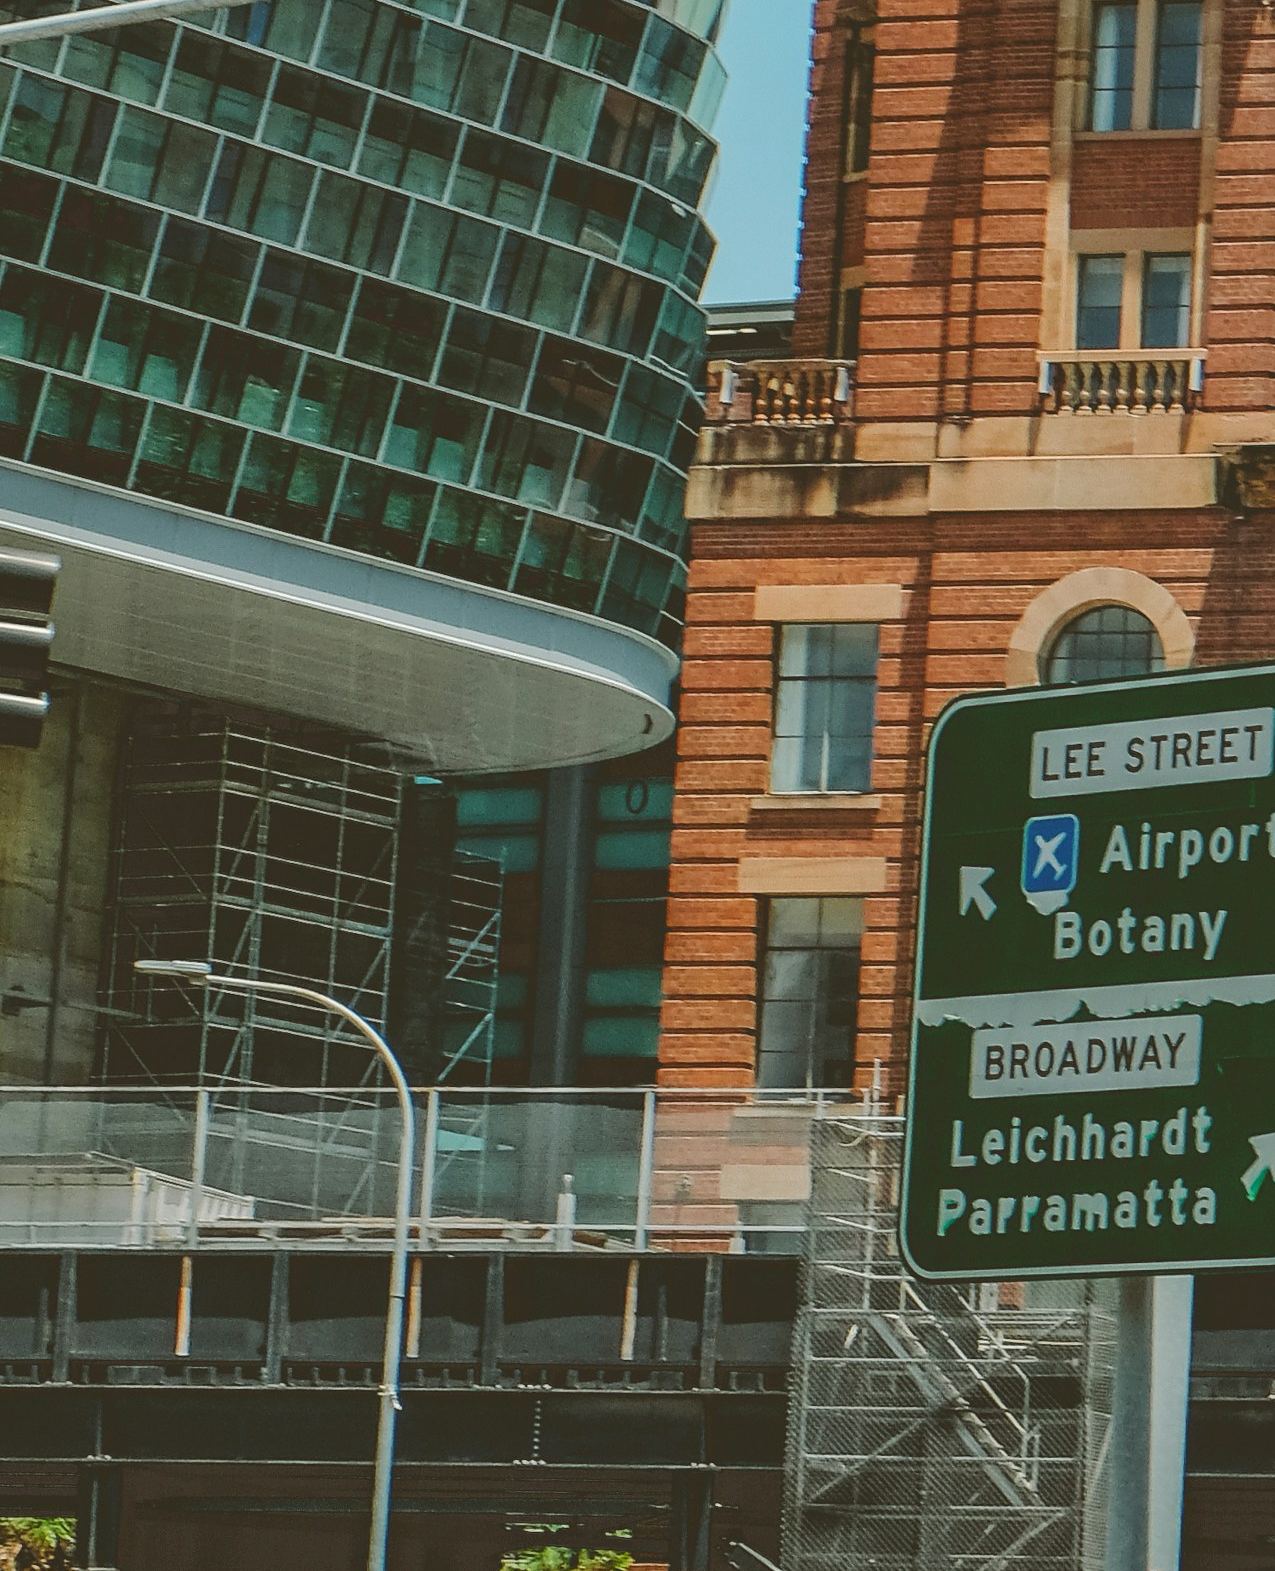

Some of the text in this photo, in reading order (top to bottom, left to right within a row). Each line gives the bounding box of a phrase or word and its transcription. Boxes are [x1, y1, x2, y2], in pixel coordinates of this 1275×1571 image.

[1041, 724, 1264, 782] LEE STREET
[1054, 909, 1227, 961] Botany
[983, 1032, 1187, 1081] BROADWAY
[951, 1106, 1213, 1168] Leichhardt
[937, 1179, 1217, 1236] Parramatta
